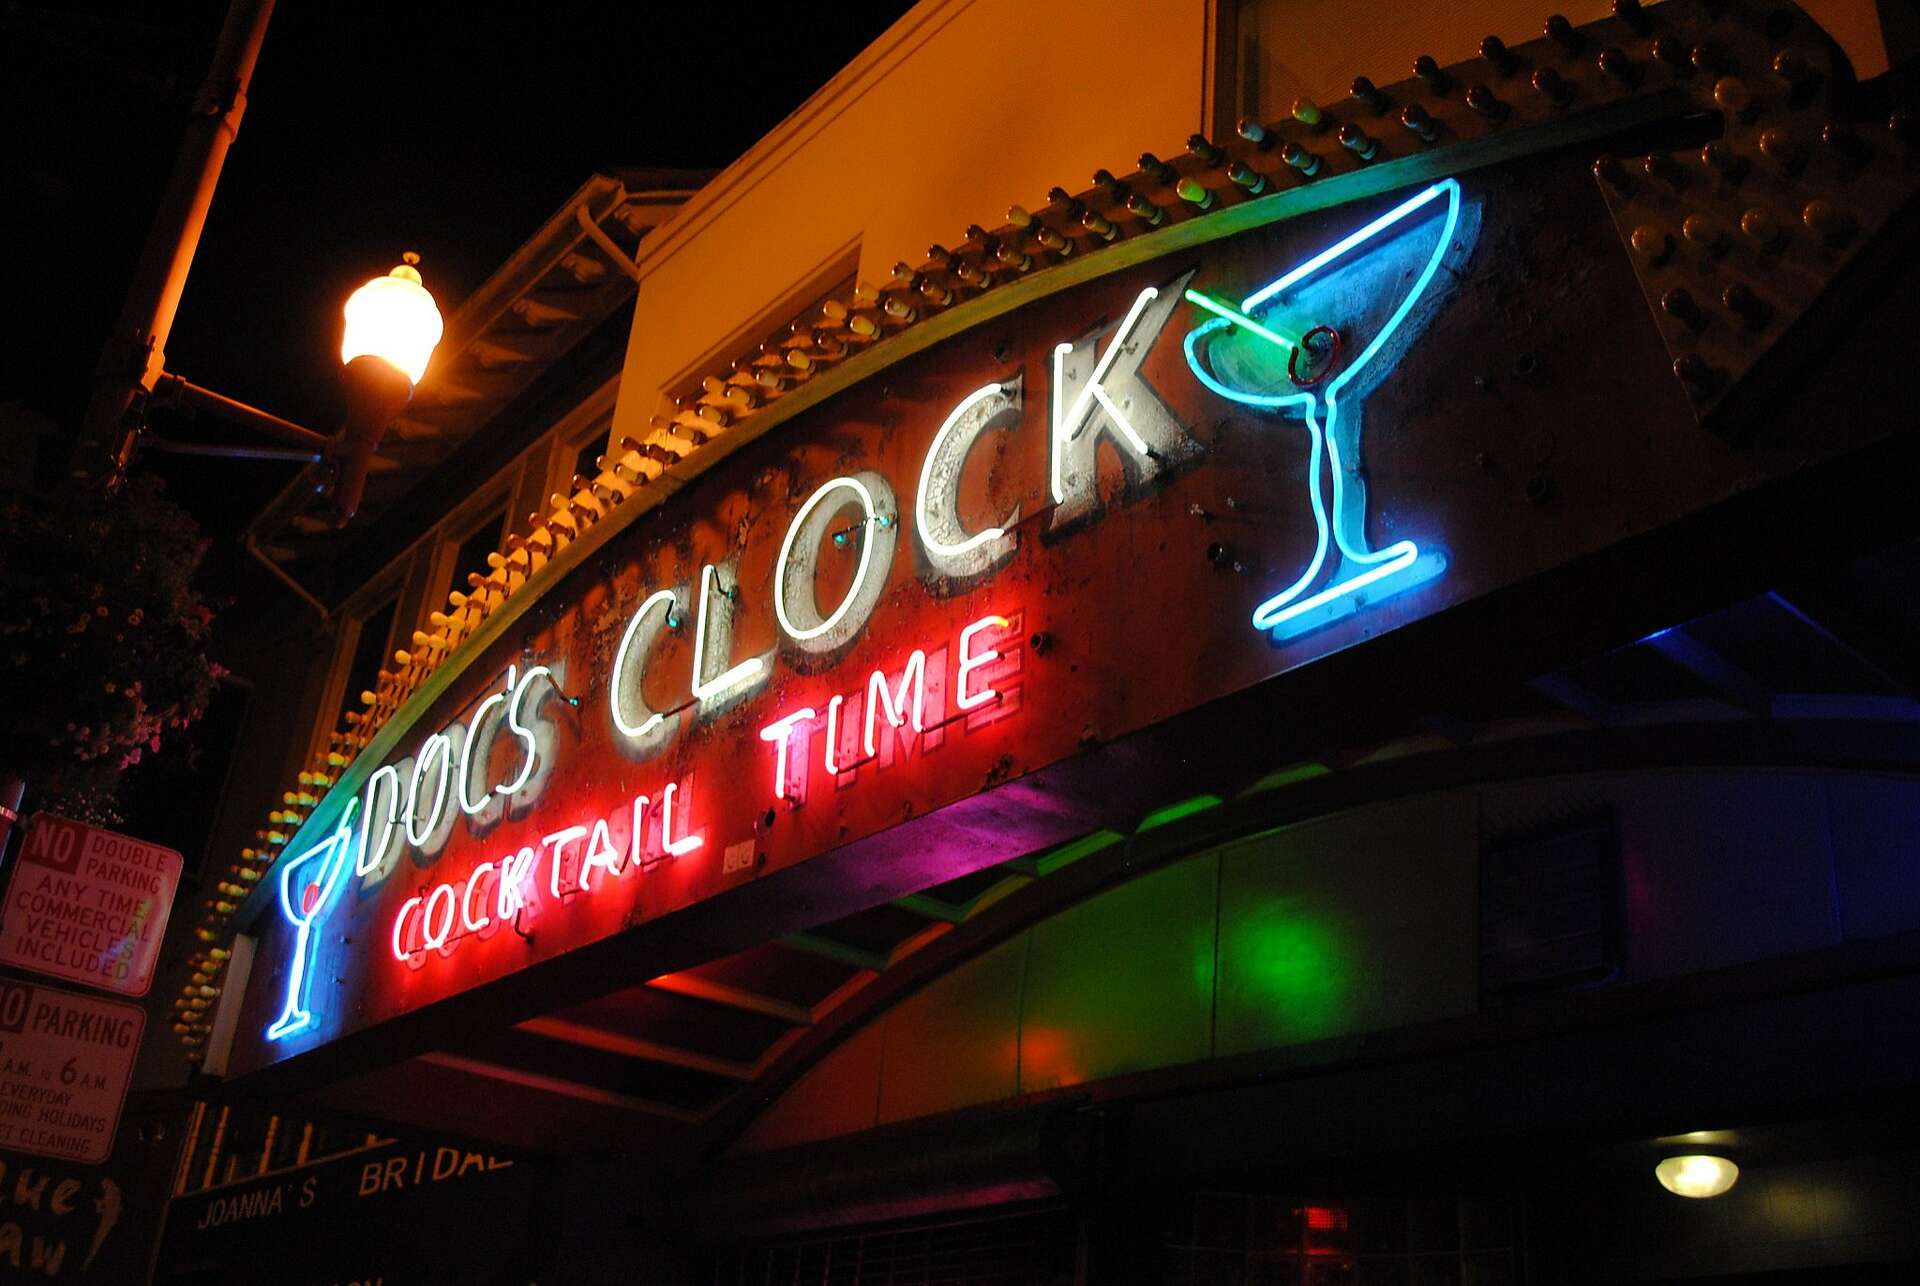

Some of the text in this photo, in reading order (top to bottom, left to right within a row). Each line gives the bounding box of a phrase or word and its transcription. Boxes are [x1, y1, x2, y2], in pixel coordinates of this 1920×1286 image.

[356, 275, 1195, 886] DOC'S CLOCK
[392, 616, 1020, 966] COCKTAIL TIME
[31, 819, 76, 863] NO
[92, 835, 168, 873] DOUBLE
[37, 875, 151, 919] ANY TIME
[86, 858, 161, 894] PARKING
[16, 890, 149, 943] COMMERCIAL
[27, 914, 134, 960] VEHICLES
[16, 935, 130, 981] INCLUDED
[33, 1003, 133, 1048] PARKING
[60, 1056, 78, 1085] 6
[0, 1081, 73, 1106] EVERYDAY
[20, 1127, 92, 1153] CLEANING
[38, 1106, 106, 1133] HOLIDAYS
[197, 1175, 319, 1230] JOANNA'S
